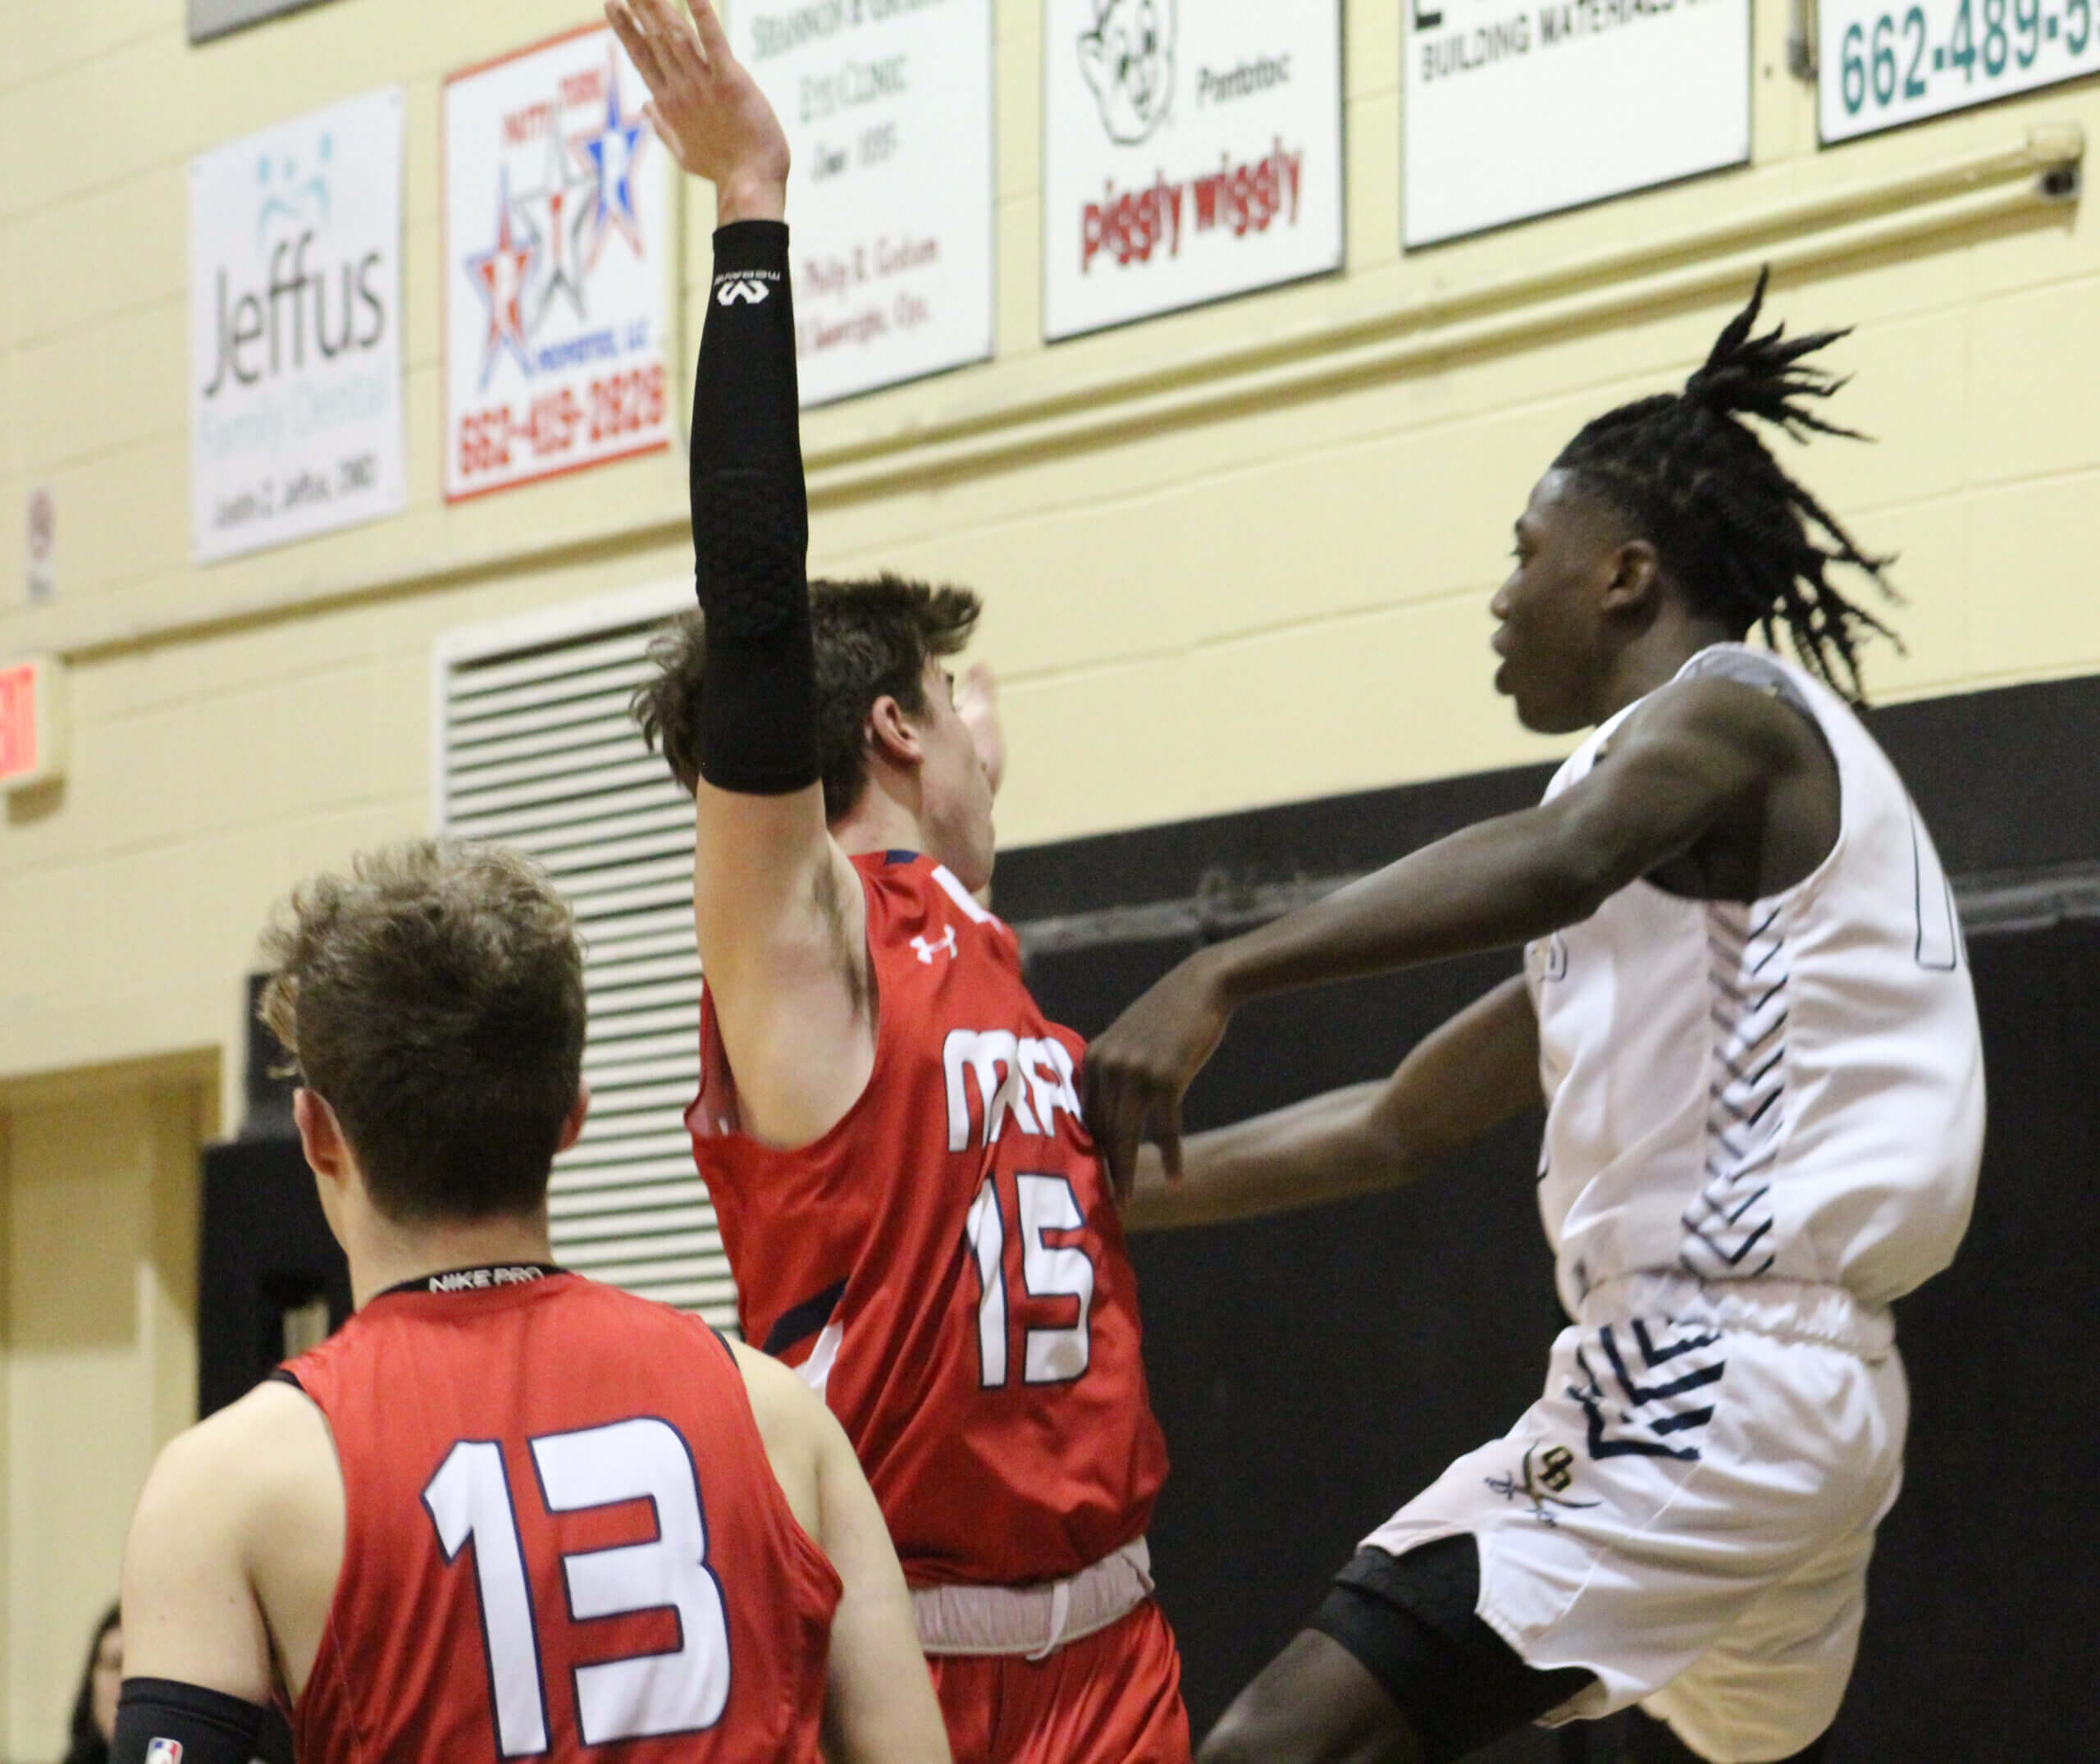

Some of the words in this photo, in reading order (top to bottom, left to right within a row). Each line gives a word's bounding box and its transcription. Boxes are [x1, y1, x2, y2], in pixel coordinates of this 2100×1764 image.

[1422, 14, 1530, 81] BUILDING
[1081, 171, 1183, 274] piggly
[1194, 135, 1303, 237] wiggly
[203, 230, 384, 399] Jeffus
[428, 1269, 492, 1293] NIKE
[966, 1171, 1094, 1388] 15
[420, 1415, 731, 1763] 13
